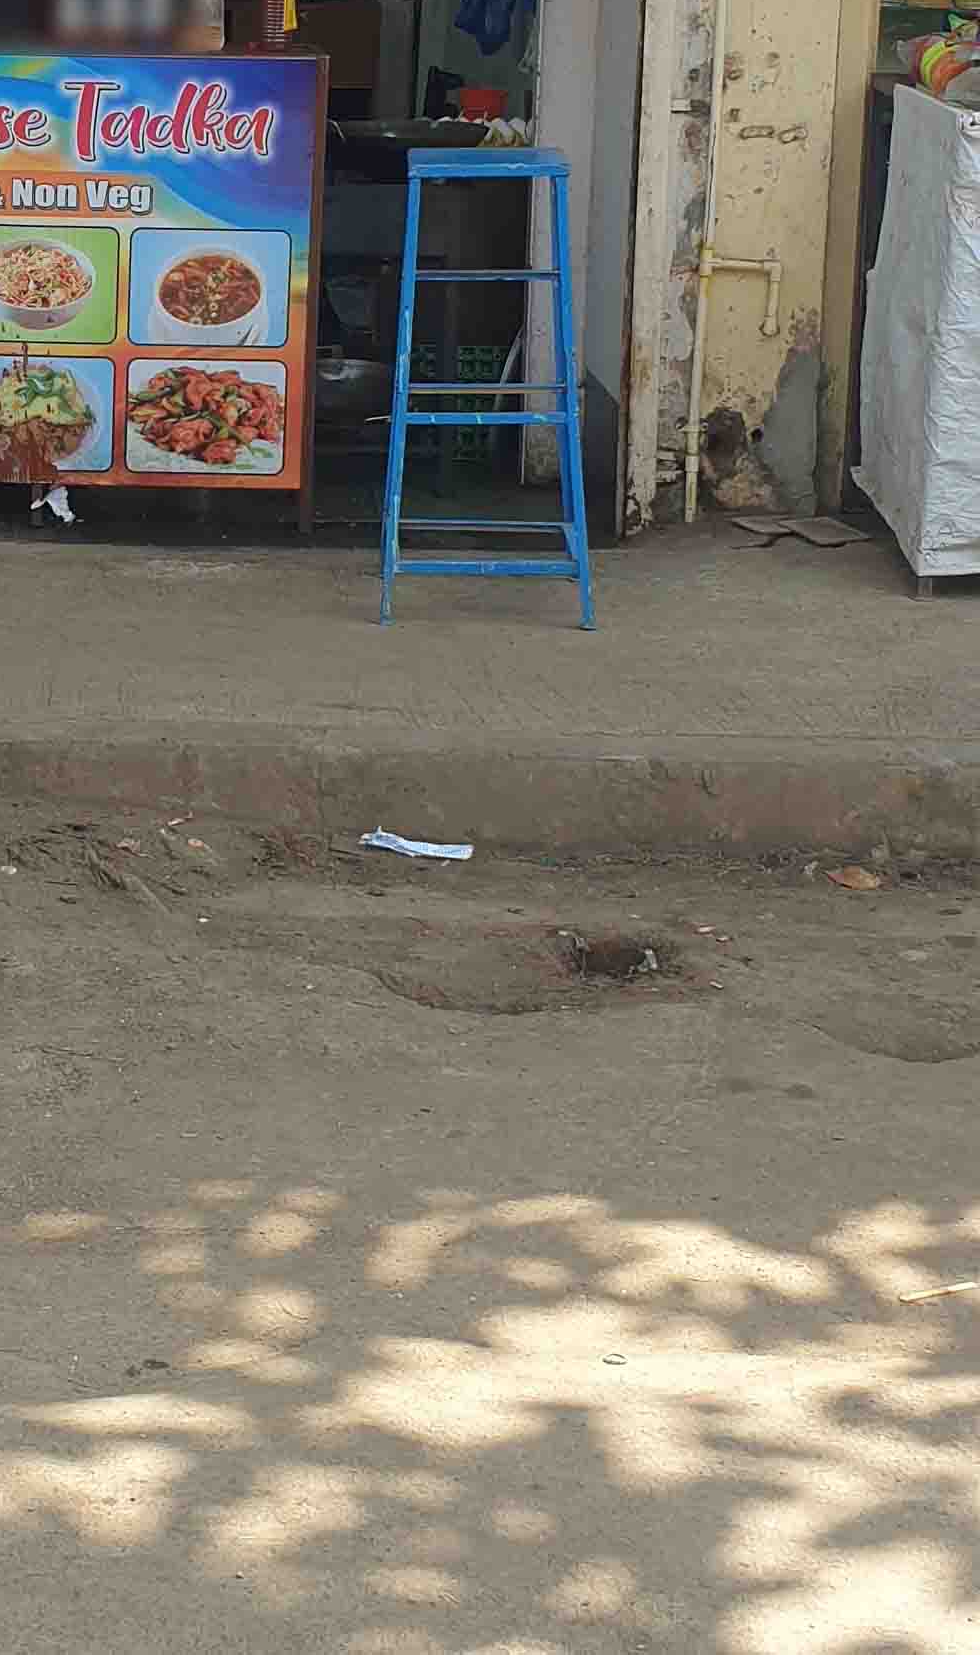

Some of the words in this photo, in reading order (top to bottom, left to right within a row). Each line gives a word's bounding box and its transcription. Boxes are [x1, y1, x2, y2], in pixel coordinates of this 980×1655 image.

[63, 80, 275, 162] Tadka
[10, 177, 78, 210] Non
[86, 180, 154, 216] Veg
